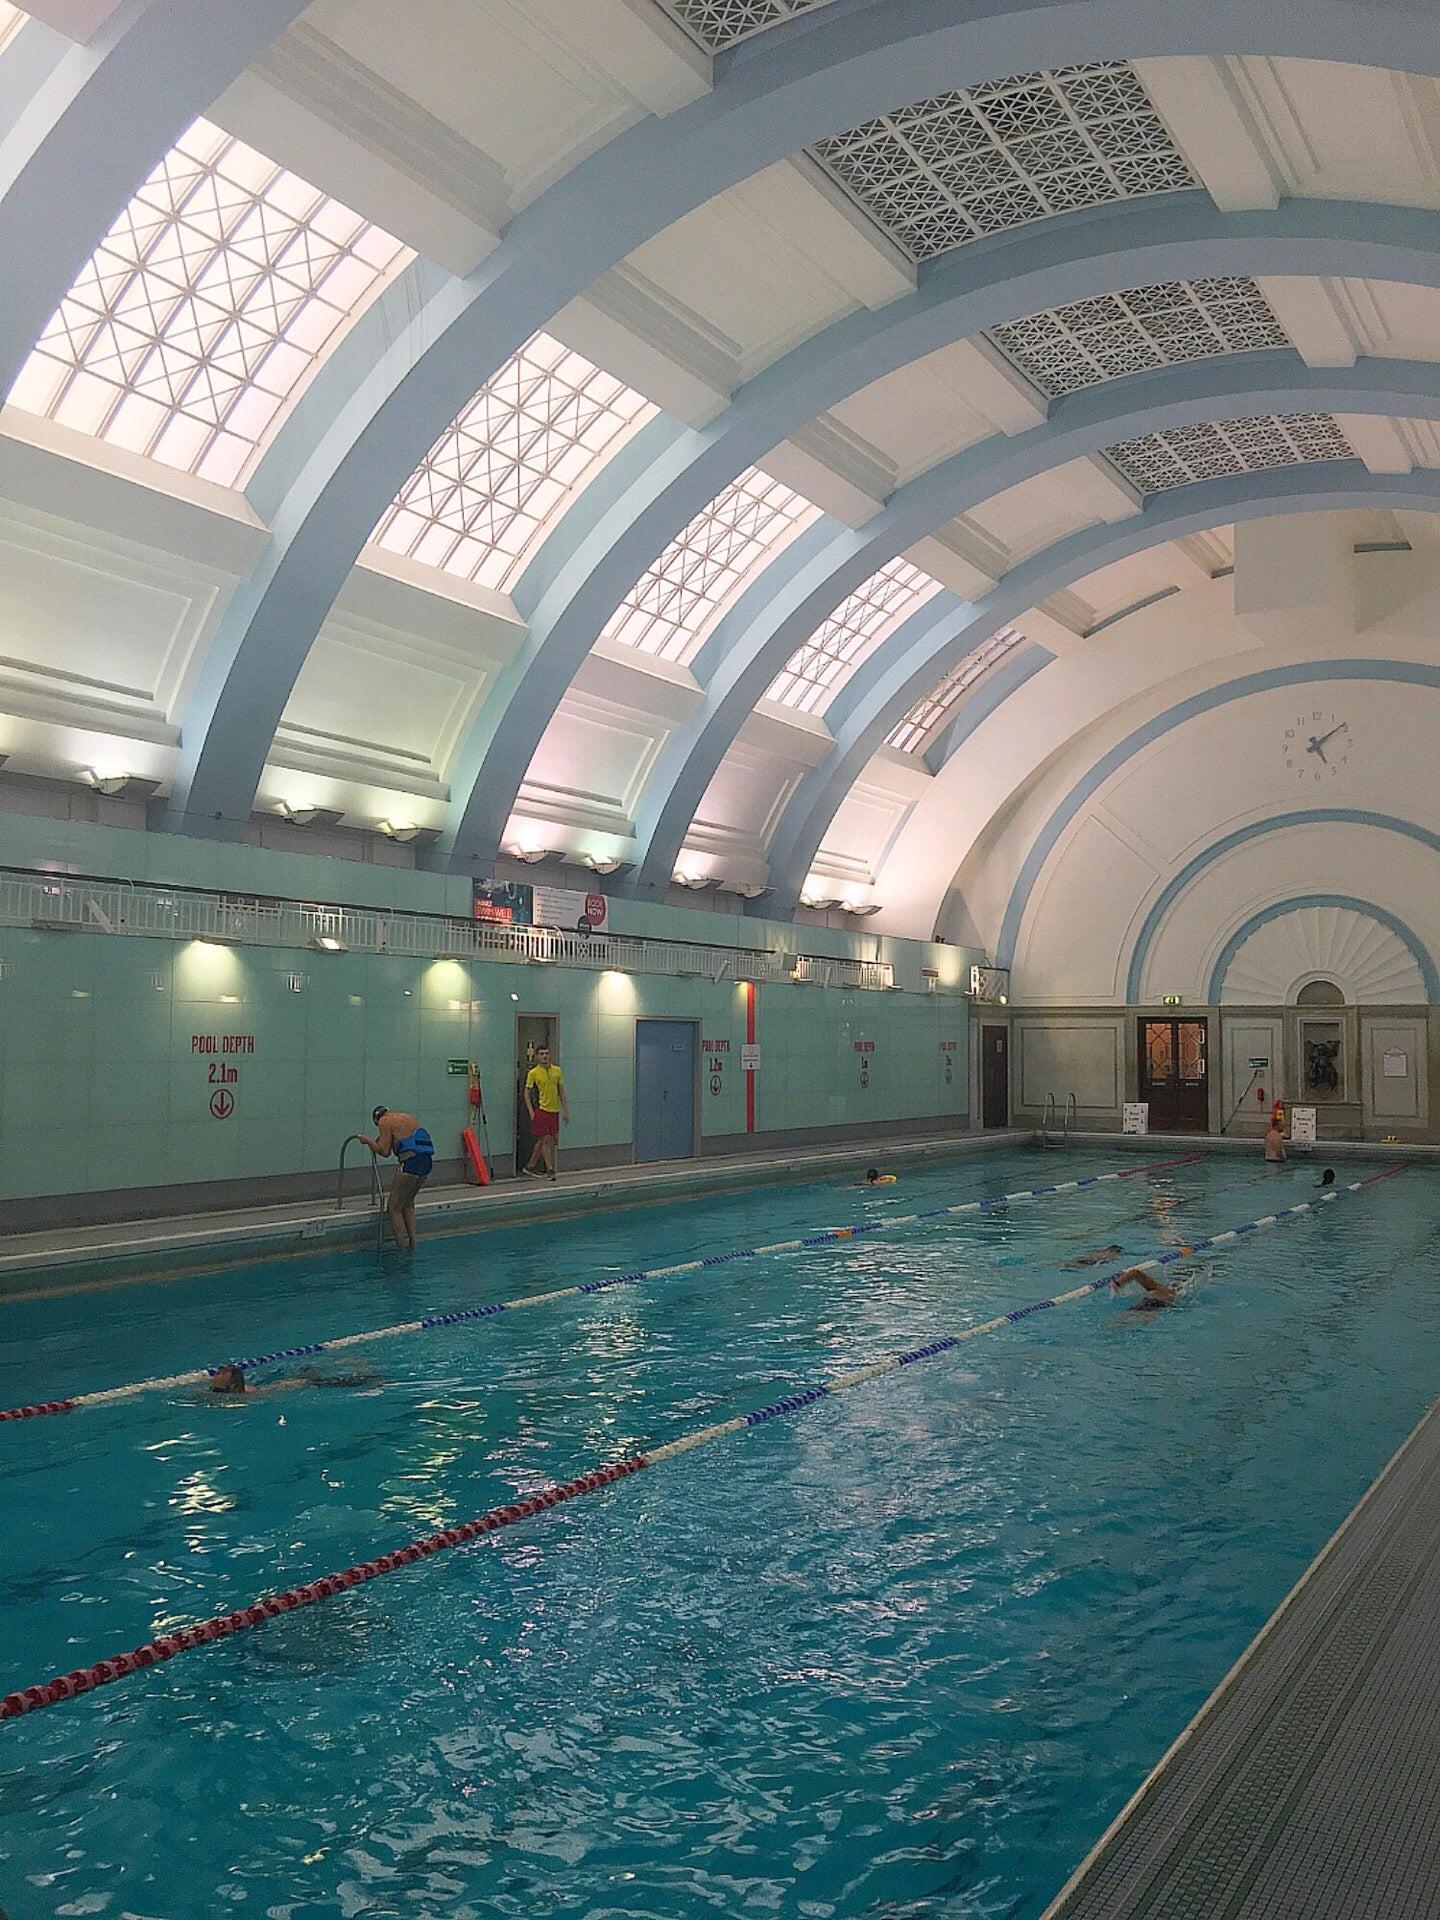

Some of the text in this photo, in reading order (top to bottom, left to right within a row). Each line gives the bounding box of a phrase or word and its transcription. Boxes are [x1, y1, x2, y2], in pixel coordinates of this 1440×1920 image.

[587, 907, 604, 916] NOW
[191, 1035, 254, 1054] POOL DEPTH
[208, 1062, 238, 1084] 2.1m
